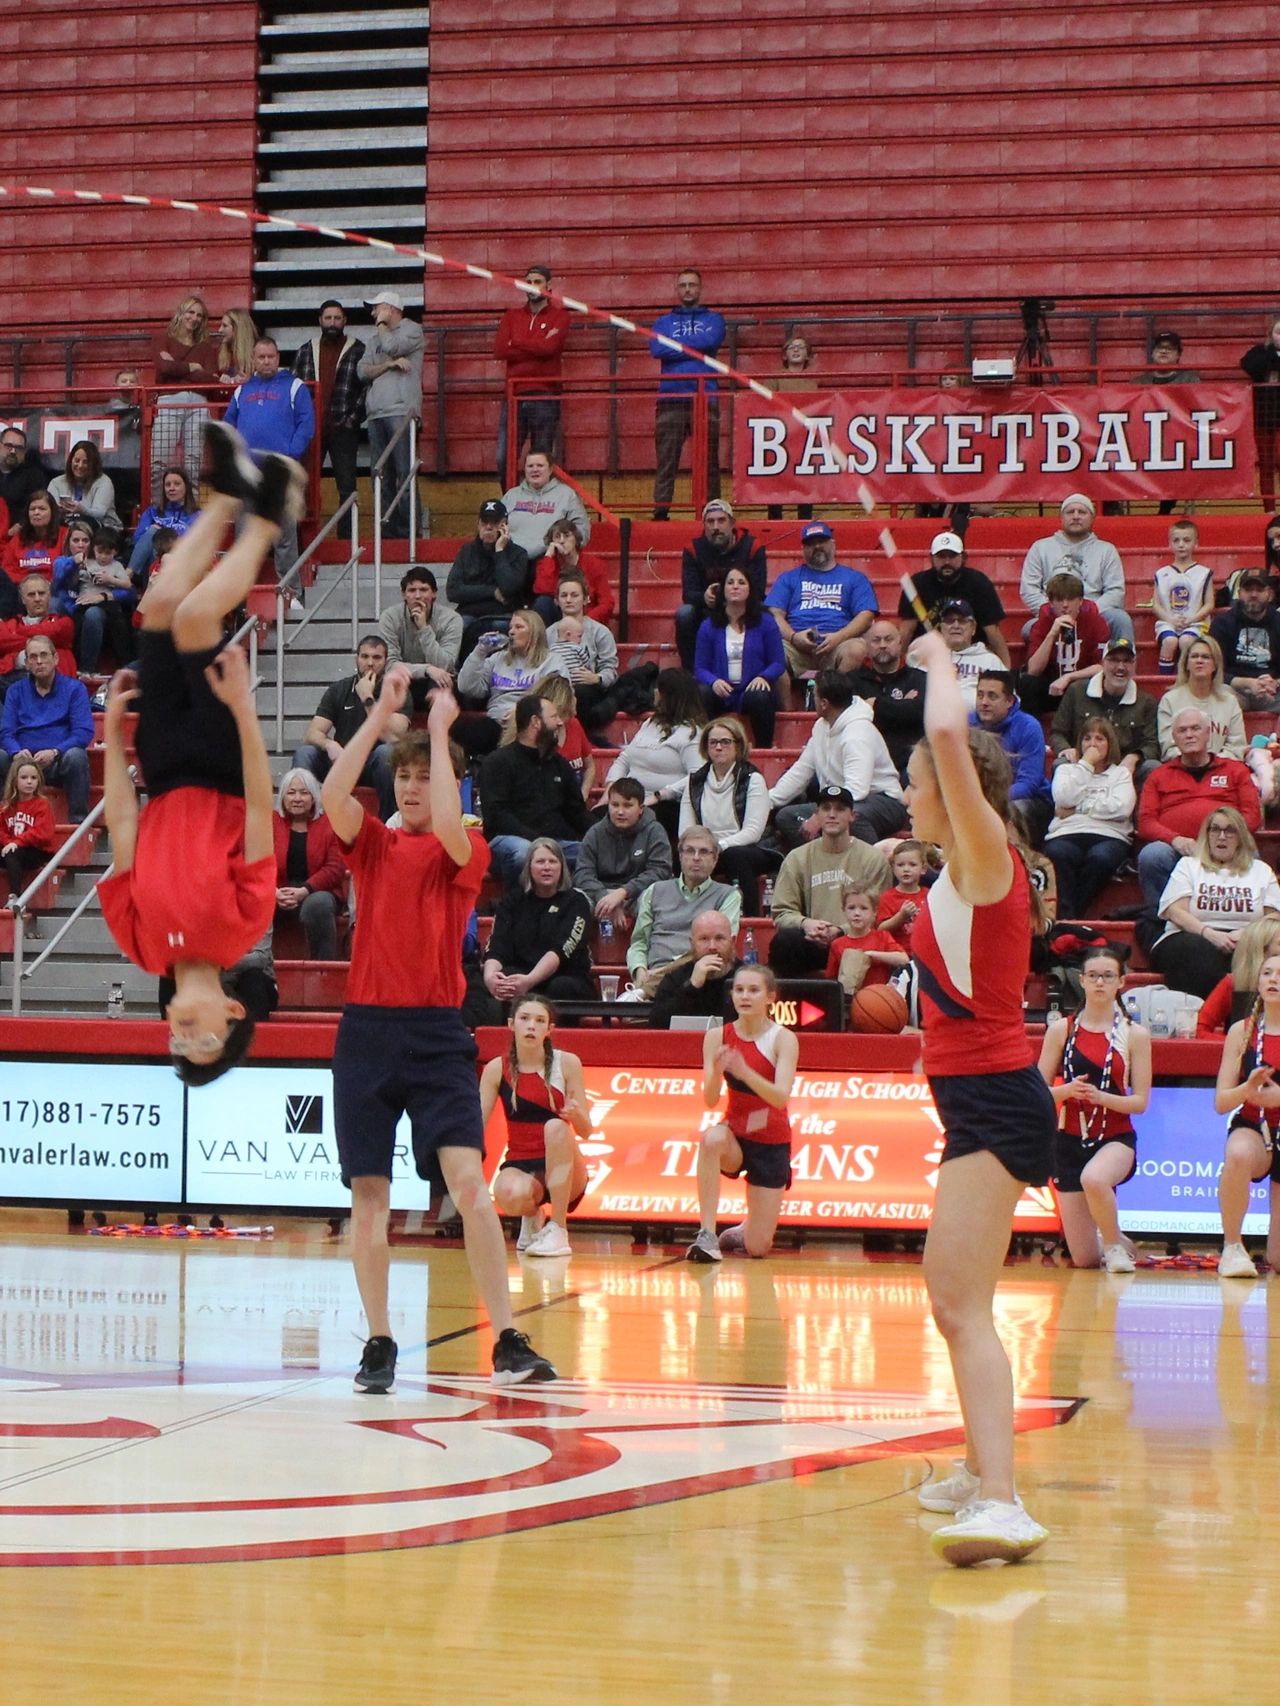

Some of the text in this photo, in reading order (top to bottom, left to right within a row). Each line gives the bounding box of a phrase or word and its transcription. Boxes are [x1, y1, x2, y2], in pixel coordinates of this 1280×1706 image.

[747, 411, 1234, 477] BASKETBALL
[1198, 882, 1253, 899] CENTER
[1196, 896, 1254, 913] GROVE
[611, 1072, 696, 1096] CENTER
[843, 1077, 934, 1100] SCHOOL
[800, 1113, 837, 1135] the
[198, 1140, 410, 1167] VAN VAR
[660, 1140, 880, 1182] TANS
[264, 1170, 343, 1182] LAW FIRM
[600, 1194, 676, 1213] MELVIN
[817, 1201, 934, 1220] GYMNASIUM
